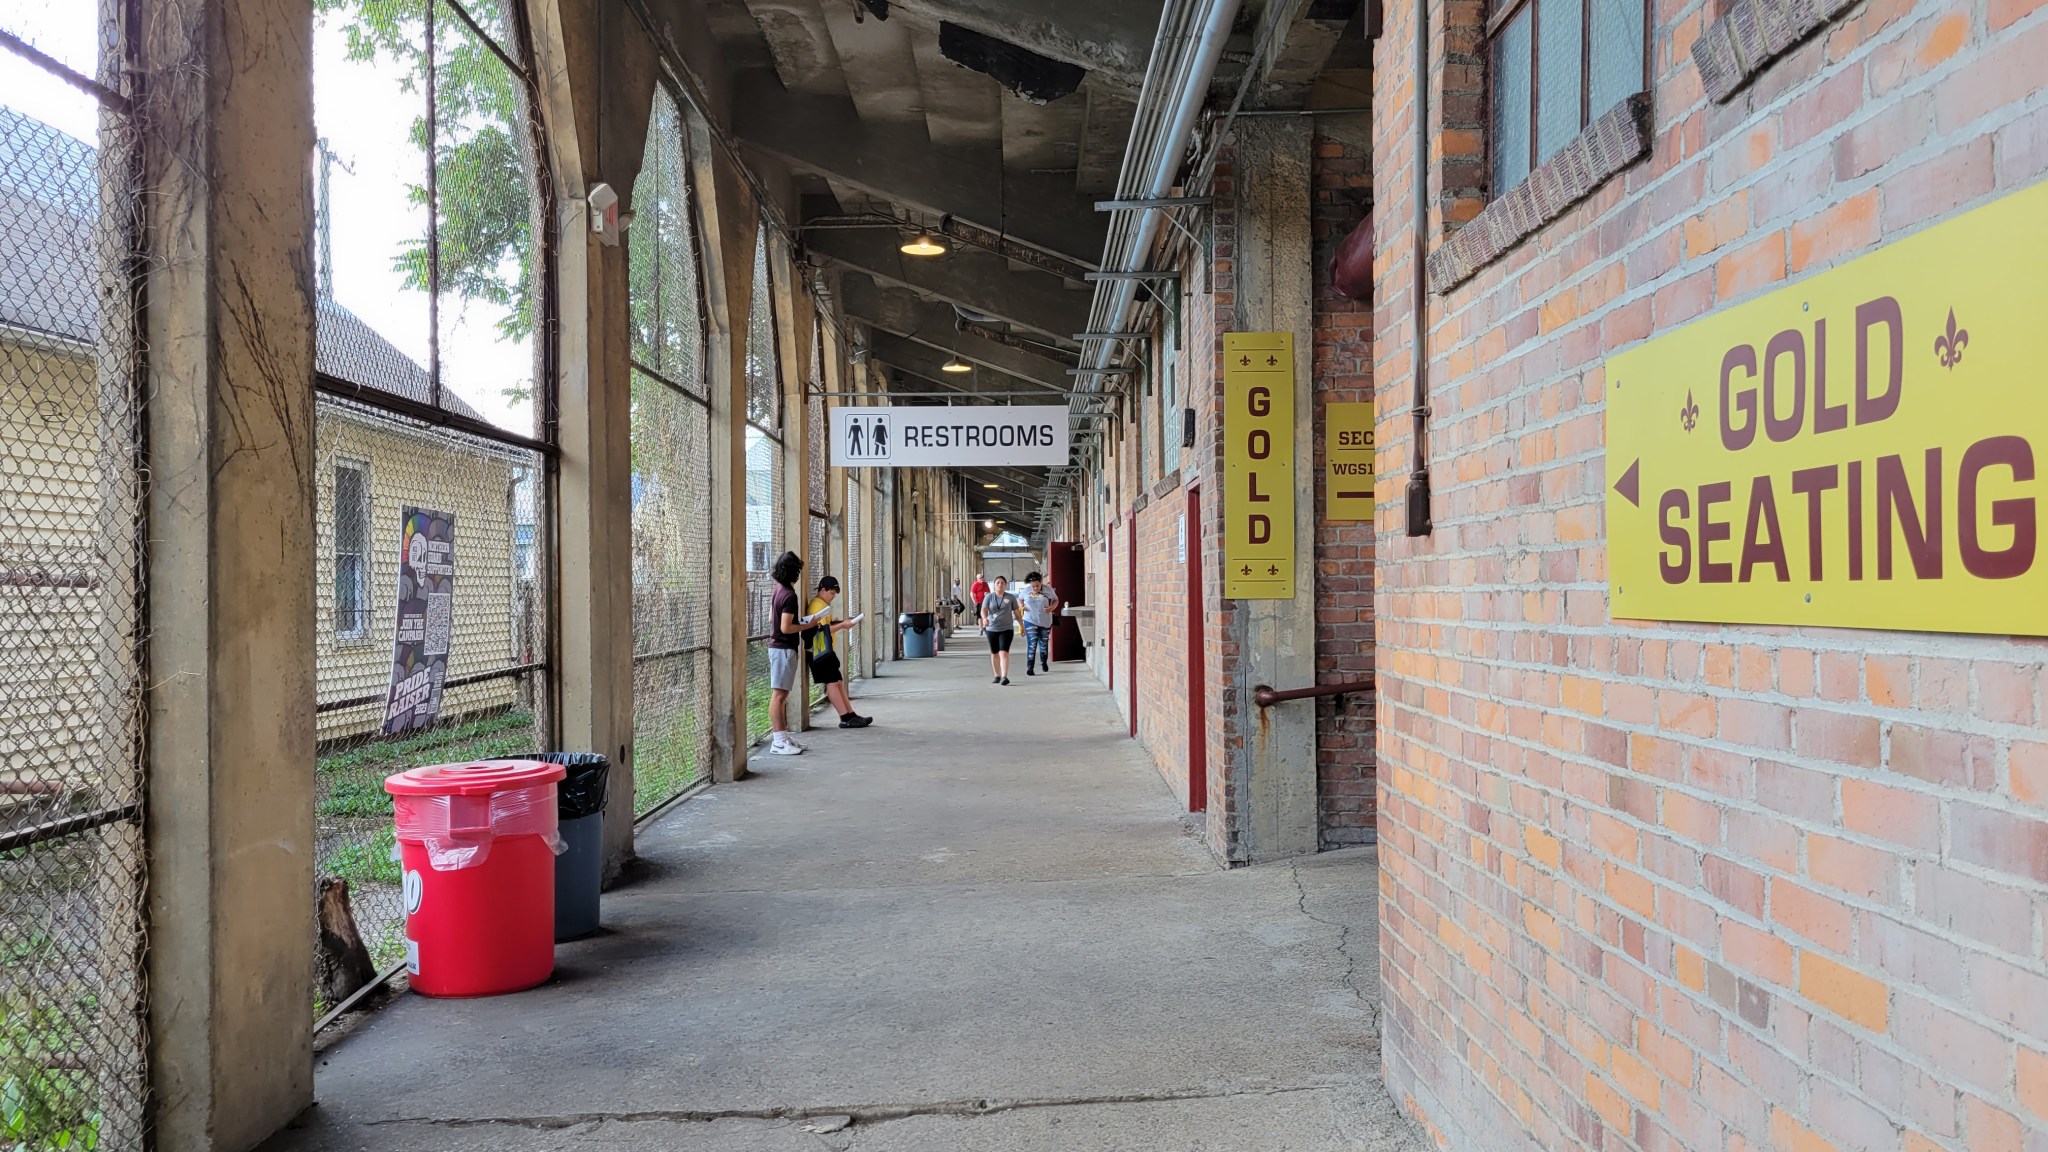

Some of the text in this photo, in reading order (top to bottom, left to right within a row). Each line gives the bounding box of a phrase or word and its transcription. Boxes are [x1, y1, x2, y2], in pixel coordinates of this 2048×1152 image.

[1719, 296, 1904, 451] GOLD
[904, 424, 1054, 447] RESTROOMS
[1247, 386, 1271, 545] GOLD
[1658, 435, 2037, 585] SEATING
[398, 629, 424, 642] CAMPAIGN
[400, 618, 424, 630] JOIN THE
[393, 666, 431, 701] PRIDE
[387, 683, 431, 720] RAISER
[415, 702, 428, 714] 2023
